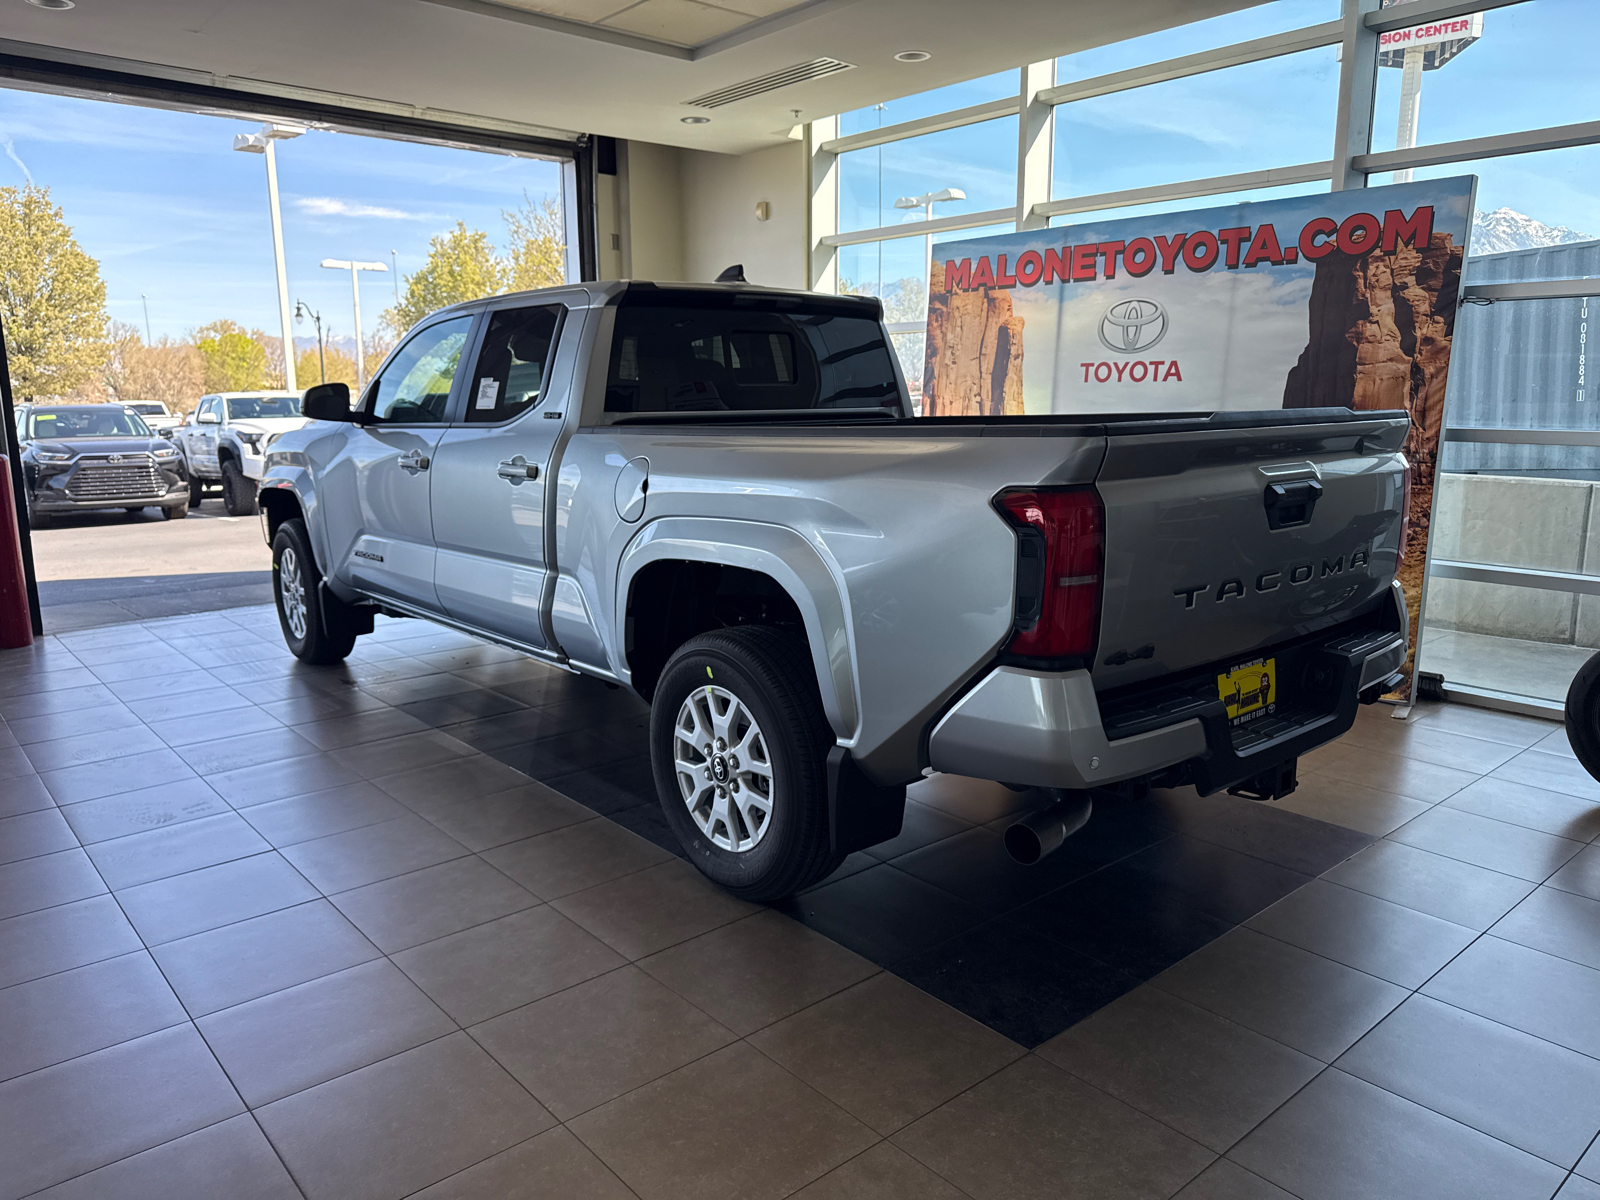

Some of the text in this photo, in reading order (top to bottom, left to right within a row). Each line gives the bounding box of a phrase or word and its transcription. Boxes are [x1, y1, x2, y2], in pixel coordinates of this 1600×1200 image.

[1415, 19, 1469, 39] CENTER
[944, 205, 1434, 293] MALONETOYOTA.COM
[1080, 360, 1183, 384] TOYOTA
[1578, 322, 1587, 386] 081884
[1173, 549, 1371, 610] TACOMA
